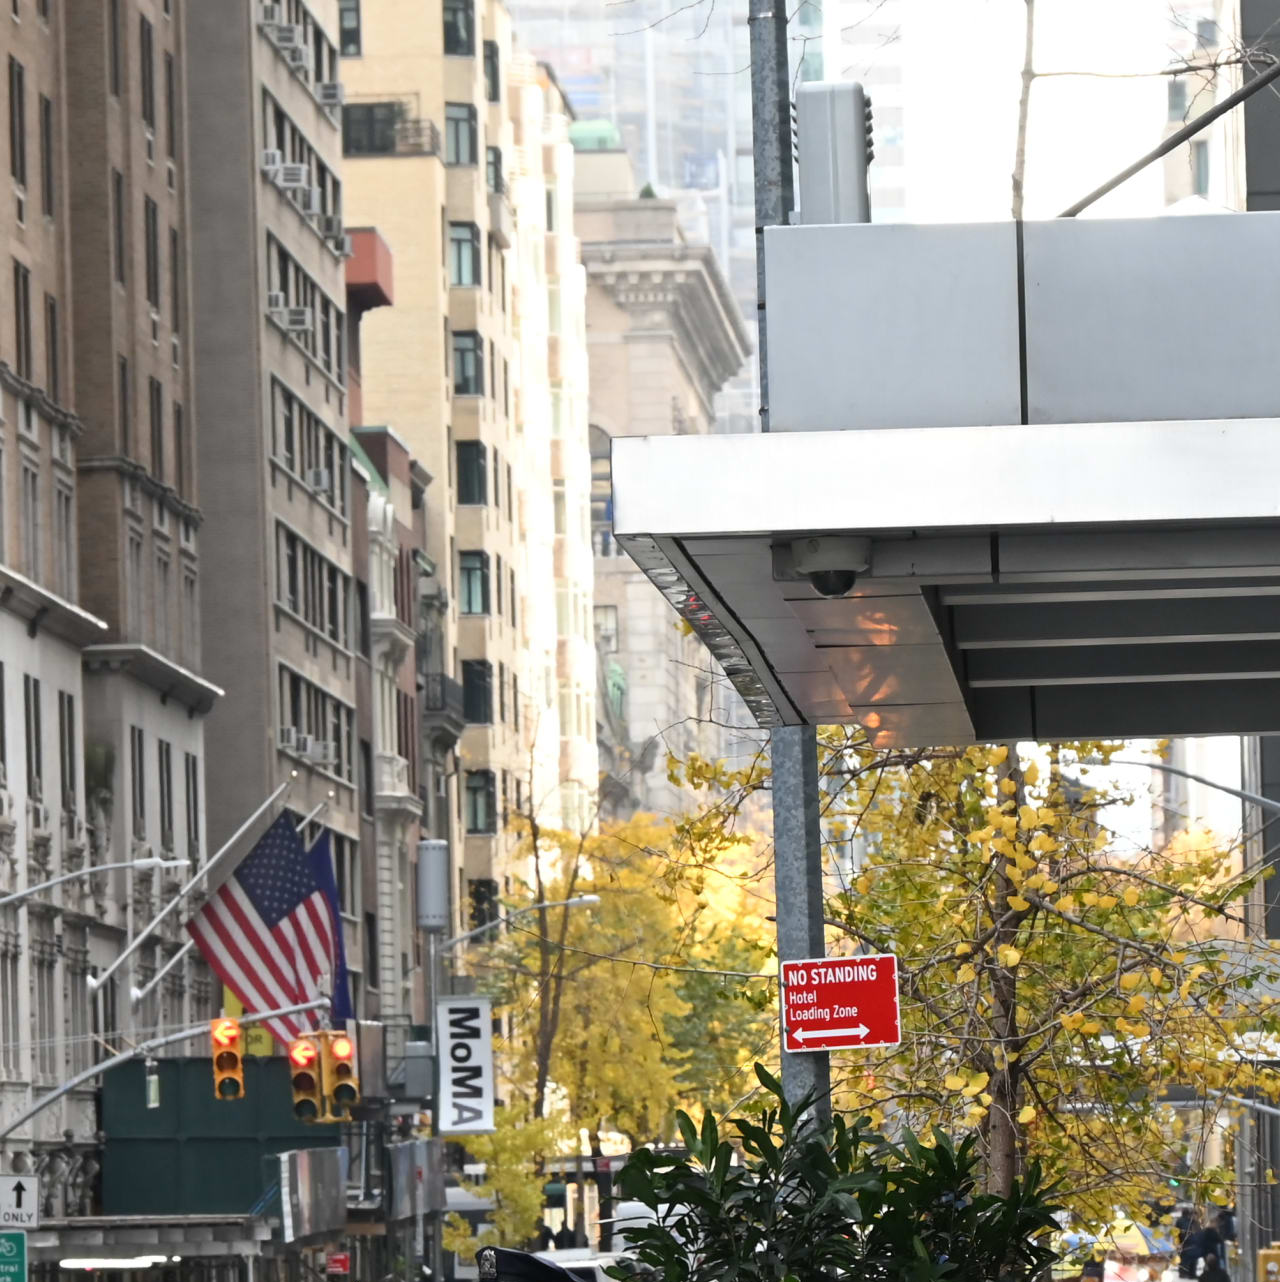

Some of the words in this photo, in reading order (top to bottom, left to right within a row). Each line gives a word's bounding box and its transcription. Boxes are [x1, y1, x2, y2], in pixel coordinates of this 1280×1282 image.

[788, 969, 807, 986] NO
[811, 965, 877, 984] STANDING
[789, 990, 817, 1004] Hotel
[790, 1006, 830, 1021] Loading
[833, 1005, 858, 1018] Zone
[448, 1006, 485, 1127] MoMA
[3, 1212, 34, 1222] ONLY
